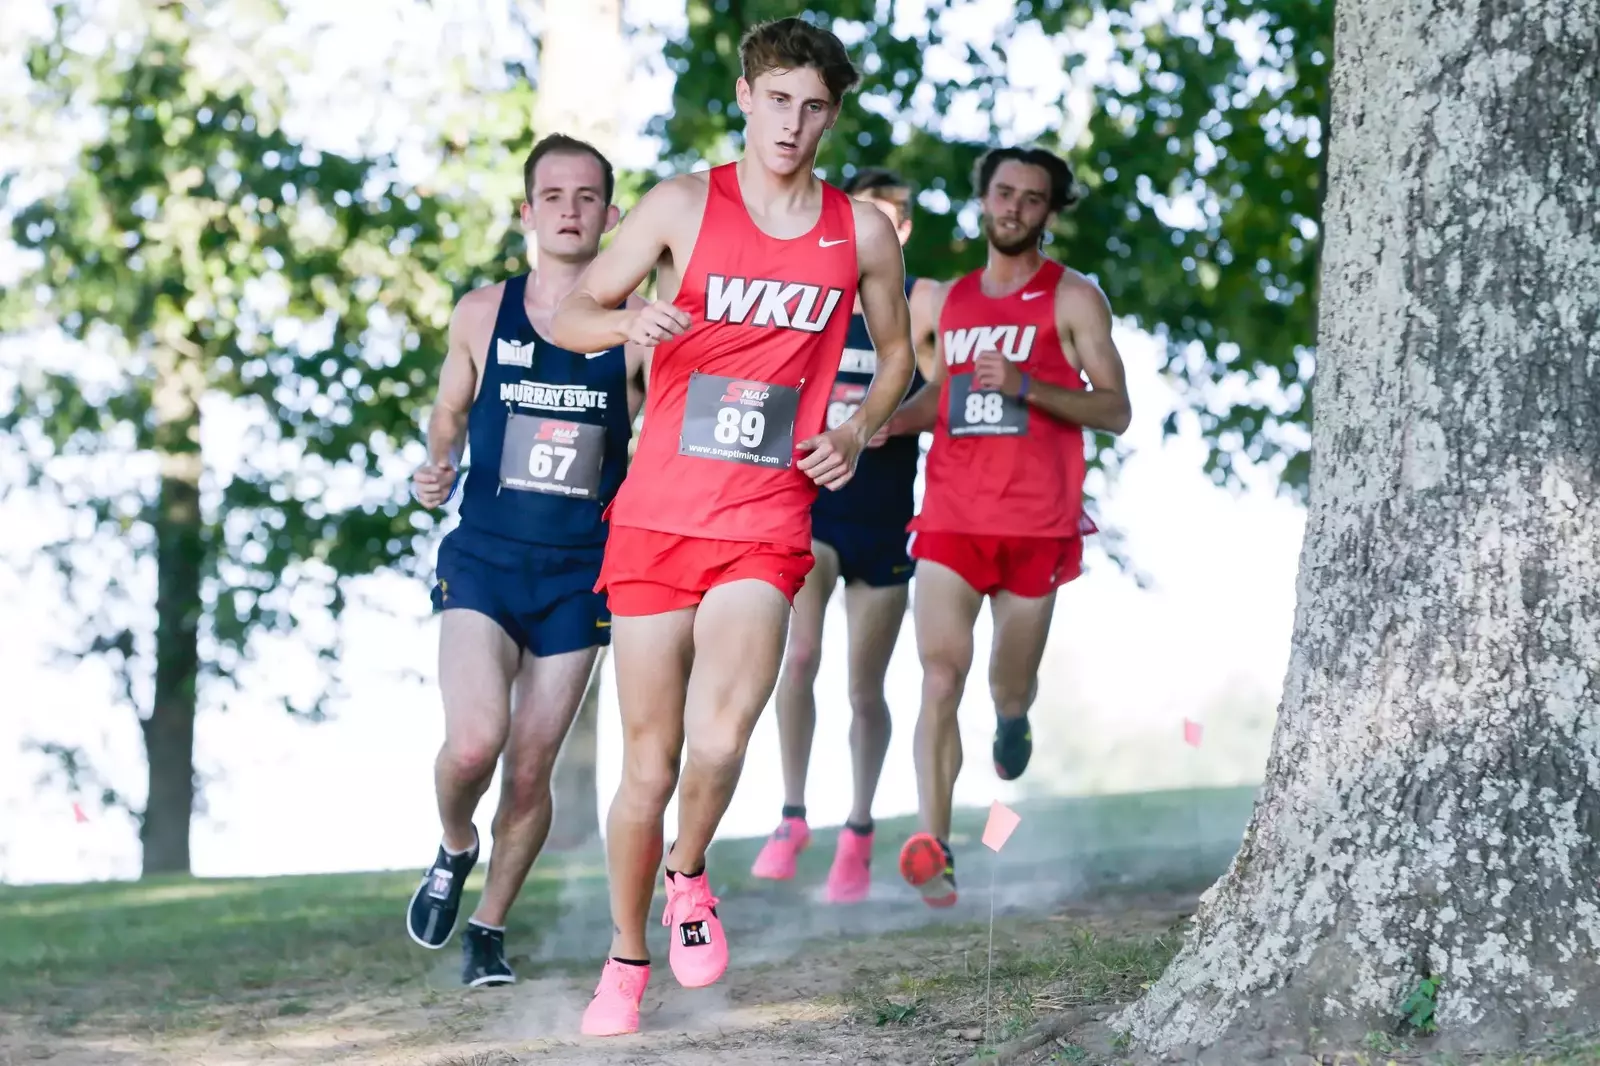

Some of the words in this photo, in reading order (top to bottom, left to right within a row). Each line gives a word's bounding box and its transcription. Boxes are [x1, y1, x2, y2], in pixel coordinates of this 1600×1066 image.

[704, 273, 845, 333] WKU
[943, 325, 1037, 366] WKU
[500, 383, 563, 407] MURRAY
[563, 389, 608, 409] STATE
[720, 381, 770, 402] SNAP
[964, 393, 1003, 424] 88
[714, 407, 765, 448] 89
[528, 443, 577, 480] 67
[688, 444, 780, 464] www.snaptiming.com
